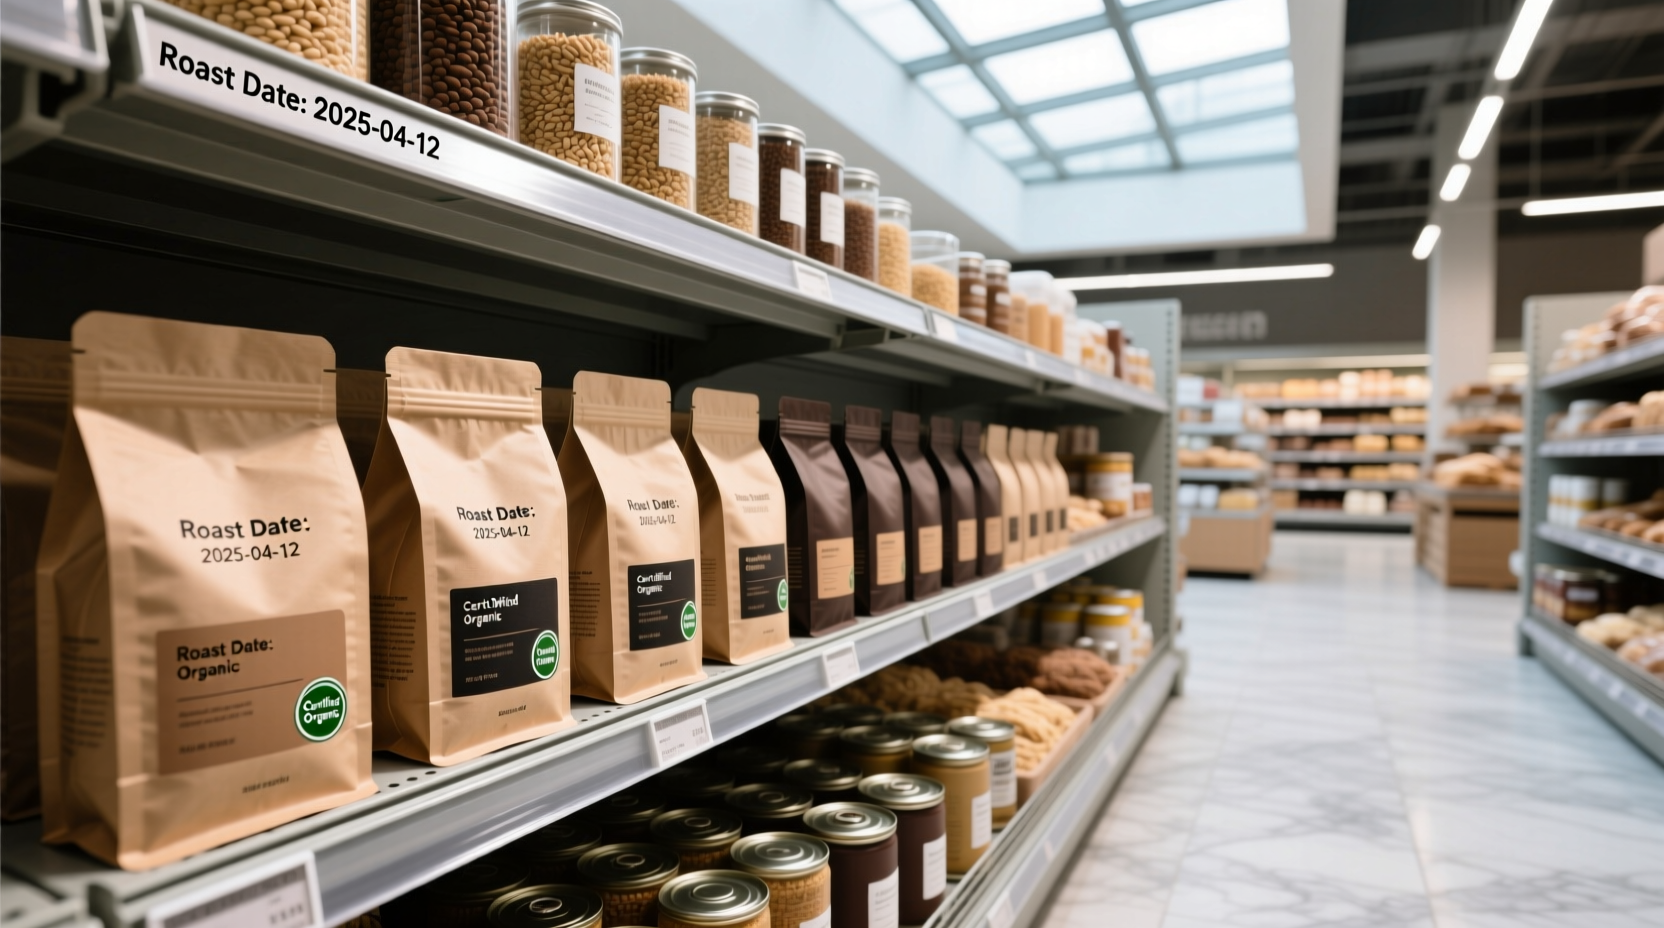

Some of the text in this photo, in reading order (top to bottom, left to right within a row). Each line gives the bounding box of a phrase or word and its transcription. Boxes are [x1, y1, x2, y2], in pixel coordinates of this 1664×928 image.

[159, 41, 441, 160] Roast Date: 2025-04-12
[456, 505, 536, 521] Roast Date:
[179, 516, 311, 540] Roast Date:
[200, 541, 302, 564] 2025-04-12
[463, 611, 503, 628] Organic
[176, 638, 275, 663] Roast Date:
[176, 659, 241, 682] Organic
